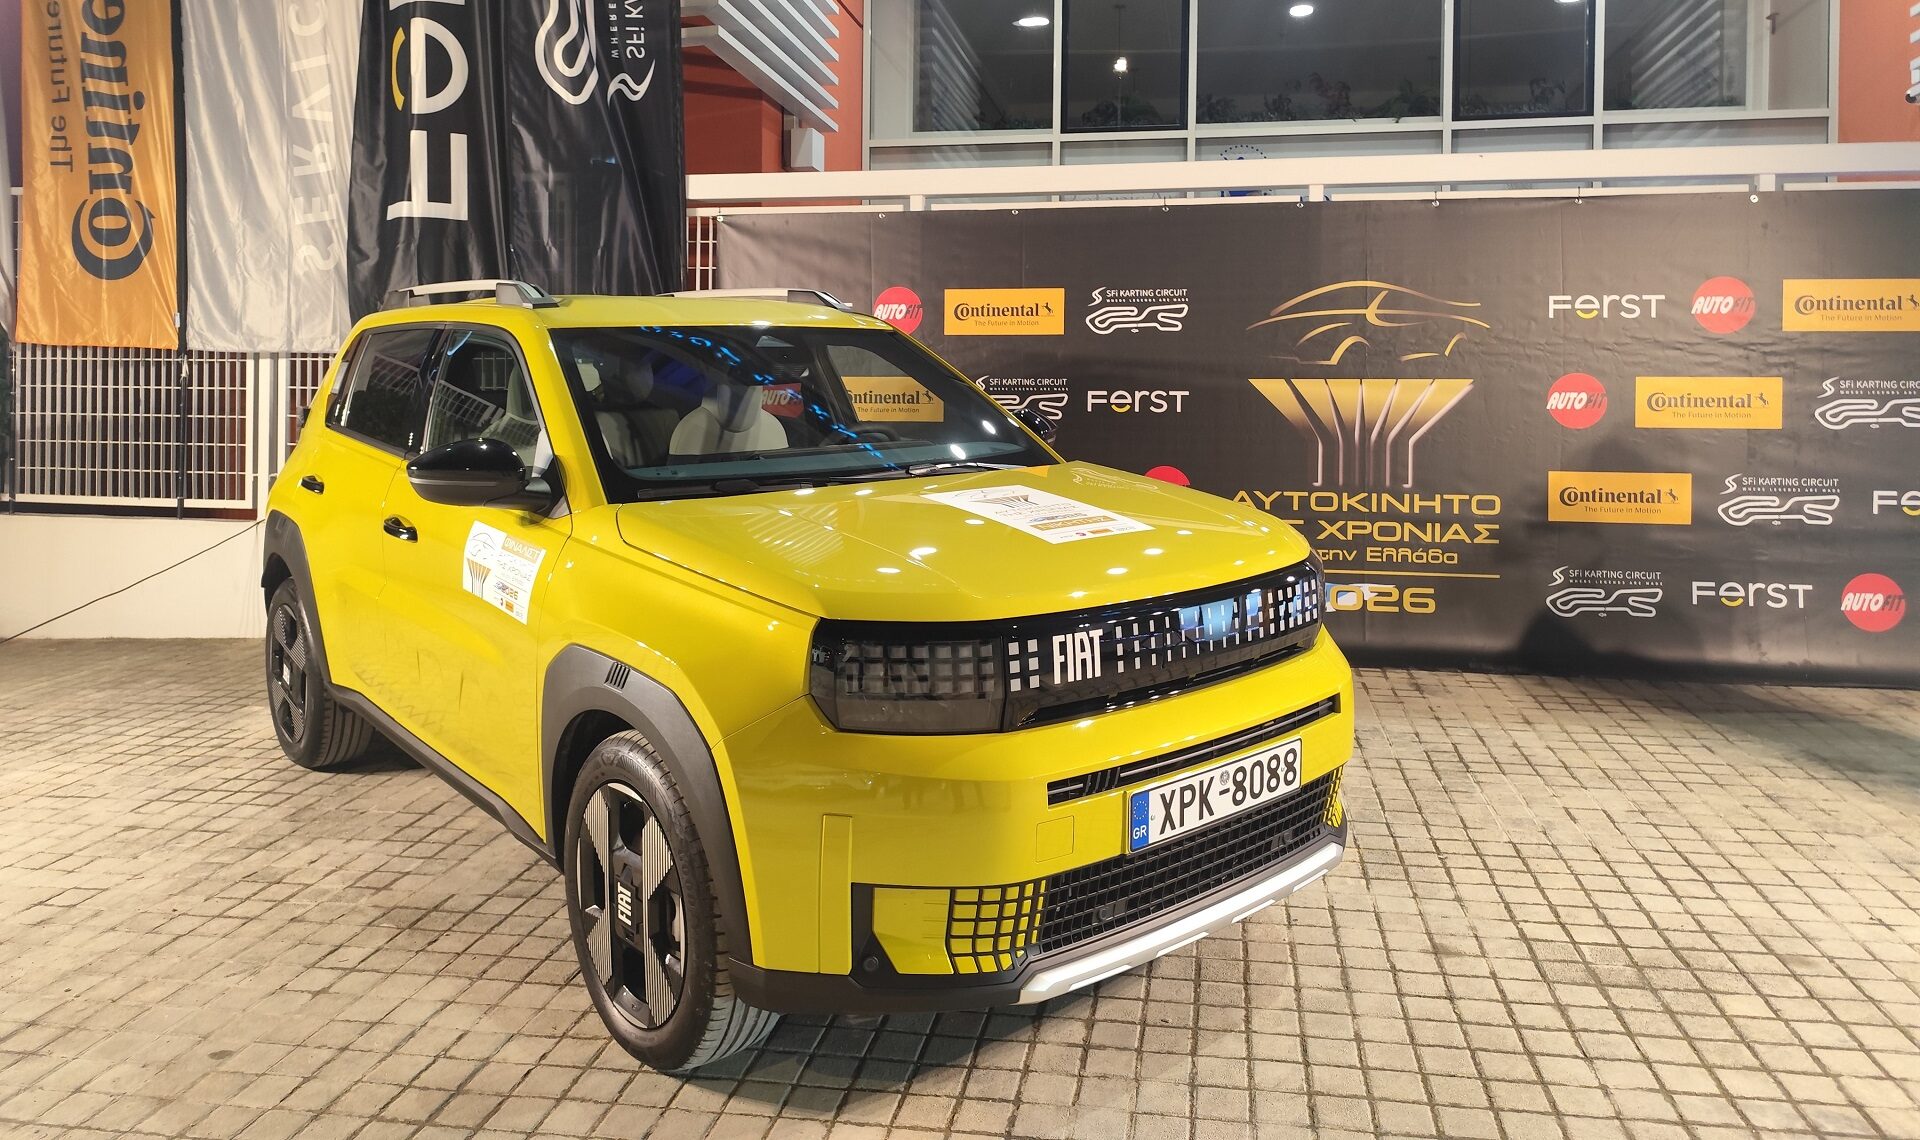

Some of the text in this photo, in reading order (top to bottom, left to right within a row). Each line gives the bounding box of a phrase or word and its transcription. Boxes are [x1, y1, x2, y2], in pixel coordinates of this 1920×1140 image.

[1120, 289, 1154, 297] KARTING
[1155, 288, 1188, 297] CIRCUIT
[953, 302, 1040, 321] Continental
[1794, 294, 1903, 315] Continental
[1002, 378, 1036, 386] KARTING
[1036, 378, 1068, 386] CIRCUIT
[1856, 380, 1898, 389] KARTING
[847, 389, 920, 405] ntinental
[1646, 392, 1753, 412] Continental
[1758, 477, 1799, 486] KARTING
[1801, 478, 1839, 487] CIRCUIT
[1232, 490, 1502, 516] ΑΥΤΟΚΙΝΗΤΟ
[1559, 486, 1662, 507] Continental
[1316, 520, 1501, 545] ΧΡΟΝΙΑΣ
[1366, 547, 1459, 565] Ελλάδα
[1584, 570, 1624, 579] KARTING
[1625, 571, 1662, 580] CIRCUIT
[1329, 584, 1436, 614] 026
[1052, 628, 1104, 685] FIAT
[1132, 825, 1148, 840] GR
[617, 881, 632, 926] FIAT
